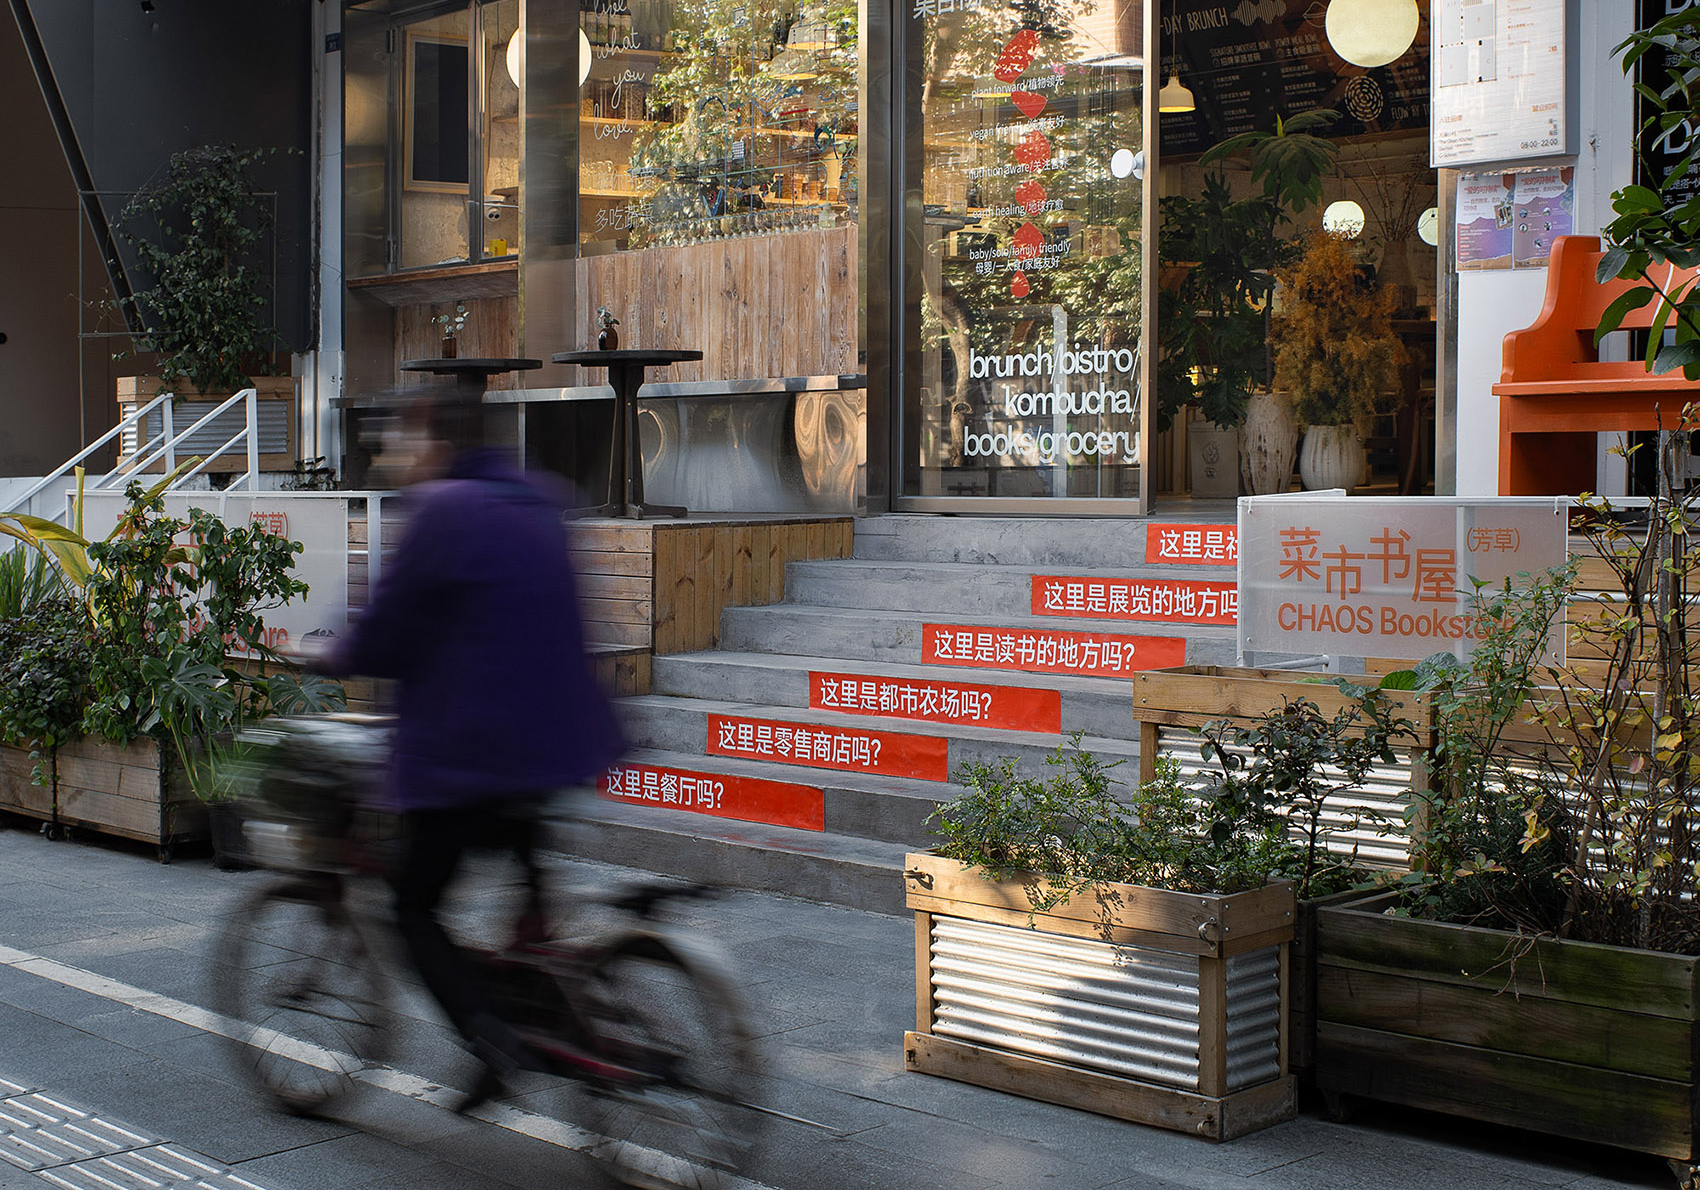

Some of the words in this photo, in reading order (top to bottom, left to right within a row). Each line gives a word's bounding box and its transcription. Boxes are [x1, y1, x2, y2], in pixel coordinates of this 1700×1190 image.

[1187, 6, 1229, 33] BRUNCH
[596, 26, 641, 60] what
[612, 71, 646, 109] you
[971, 84, 991, 102] plant
[968, 126, 994, 141] vegan
[594, 202, 655, 233] 多吃蔬菜
[972, 204, 994, 218] earth
[1038, 240, 1071, 257] friendly
[964, 424, 1140, 463] books/grocery
[1466, 527, 1521, 554] (芳草)
[1278, 526, 1458, 603] 菜市书屋
[1278, 602, 1374, 635] CHAOS
[934, 630, 1136, 671] 这里是读书的地方吗?
[820, 678, 992, 720] 这里是都市农场吗?
[718, 721, 882, 766] 这里是零售商店吗?
[606, 767, 724, 809] 这里是餐厅吗?
